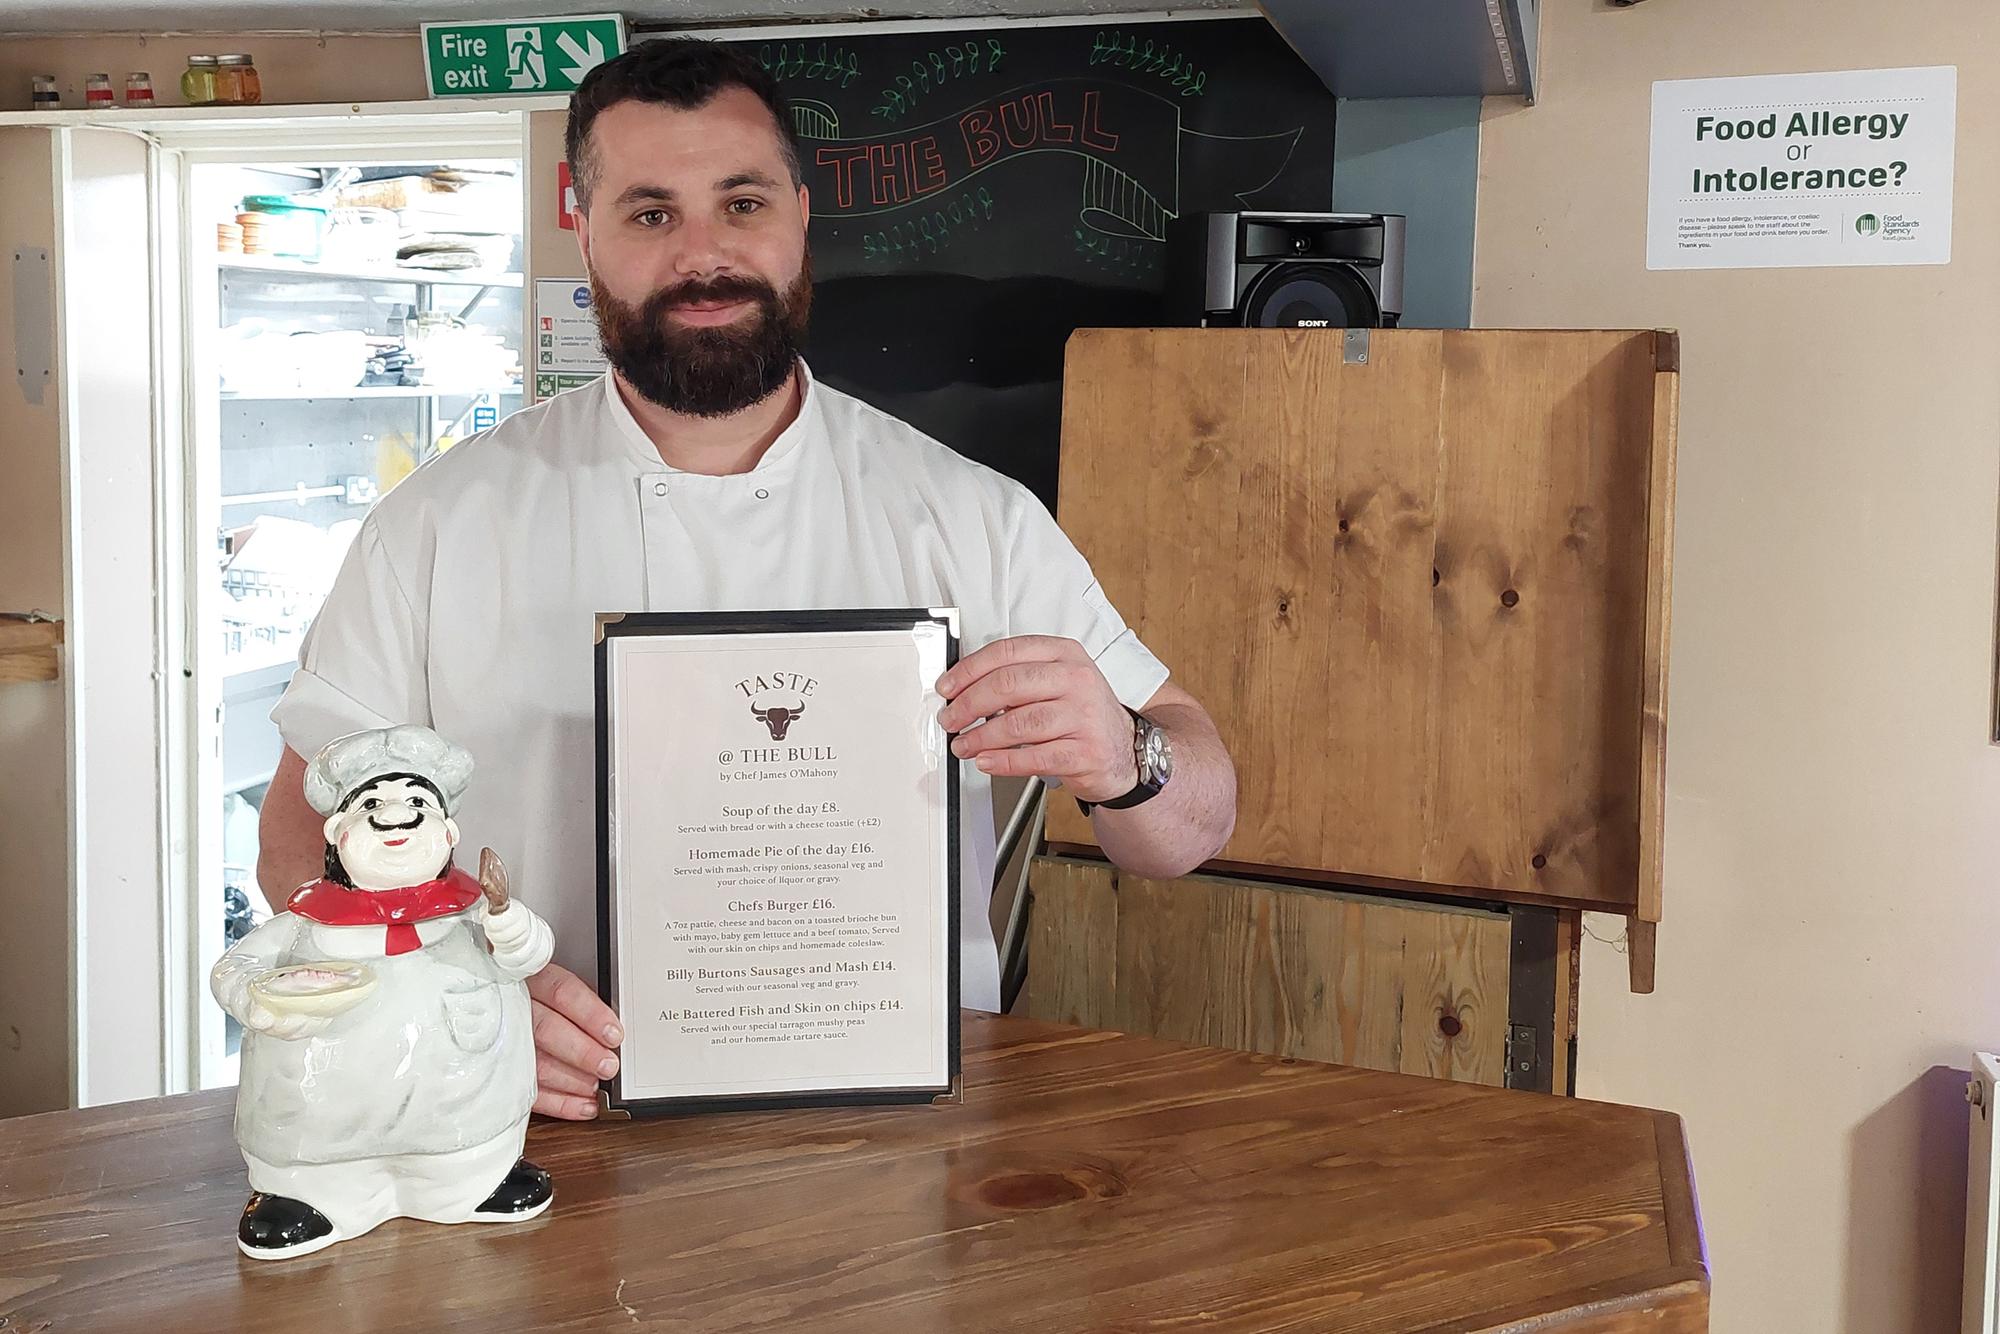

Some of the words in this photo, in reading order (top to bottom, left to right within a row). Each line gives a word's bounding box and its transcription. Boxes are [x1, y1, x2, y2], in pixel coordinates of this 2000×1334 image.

[441, 34, 487, 57] Fire
[443, 64, 488, 89] exit
[1696, 114, 1776, 141] Food
[1784, 111, 1909, 139] Allergy
[816, 136, 946, 207] THE
[959, 91, 1119, 167] BULL
[1787, 144, 1812, 161] or
[1693, 161, 1908, 192] Intolerance?
[735, 671, 819, 698] TASTE
[718, 750, 733, 765] @
[740, 748, 780, 763] THE
[788, 747, 836, 761] BULL
[720, 772, 731, 782] by
[734, 771, 756, 780] Chef
[759, 771, 786, 781] James
[722, 806, 753, 819] Soup
[756, 804, 770, 815] of
[774, 804, 793, 815] the
[797, 803, 818, 816] day
[822, 802, 839, 812] £8.
[678, 825, 706, 833] Served
[709, 824, 728, 832] with
[730, 823, 754, 831] bread
[767, 821, 786, 830] with
[795, 821, 824, 829] cheese
[826, 819, 854, 827] toastie
[857, 818, 881, 827] (+£2)
[689, 846, 760, 859] Homemade
[765, 846, 782, 856] Pie
[786, 845, 800, 856] of
[802, 845, 822, 855] the
[826, 844, 847, 857] day
[851, 842, 874, 853] £16.
[674, 866, 702, 875] Served
[726, 865, 750, 873] mash,
[753, 864, 778, 873] crispy
[781, 863, 811, 871] onions,
[814, 861, 848, 870] seasonal
[717, 880, 736, 888] your
[739, 877, 765, 885] choice
[768, 876, 776, 884] of
[779, 876, 803, 885] liquor
[817, 876, 840, 885] gravy.
[728, 900, 763, 912] Chefs
[767, 900, 808, 913] Burger
[813, 898, 835, 909] £16.
[673, 921, 688, 929] 7oz
[690, 920, 716, 931] pattie,
[719, 919, 747, 927] cheese
[749, 918, 765, 926] and
[767, 918, 792, 926] bacon
[815, 915, 845, 924] toasted
[847, 914, 878, 923] brioche
[673, 933, 691, 941] with
[694, 934, 719, 942] mayo,
[721, 932, 741, 942] baby
[743, 933, 760, 941] gem
[793, 929, 808, 937] and
[818, 928, 835, 936] beef
[872, 926, 899, 934] Served
[725, 944, 742, 952] skin
[758, 943, 779, 953] chips
[782, 942, 797, 950] and
[800, 940, 845, 949] homemade
[848, 939, 884, 947] coleslaw.
[667, 969, 694, 981] Billy
[698, 968, 746, 980] Burtons
[750, 966, 805, 977] Sausages
[809, 962, 831, 973] and
[836, 961, 868, 972] Mash
[873, 961, 895, 971] £14.
[695, 985, 723, 994] Served
[726, 984, 744, 992] with
[763, 982, 798, 990] seasonal
[801, 982, 815, 990] veg
[835, 980, 859, 989] gravy.
[659, 1010, 679, 1021] Ale
[683, 1006, 735, 1020] Battered
[739, 1005, 764, 1016] Fish
[768, 1004, 790, 1014] and
[795, 1003, 821, 1013] Skin
[825, 1004, 839, 1012] on
[844, 1000, 875, 1013] chips
[880, 1000, 903, 1010] £14.
[681, 1025, 709, 1033] Served
[749, 1021, 777, 1032] special
[780, 1021, 814, 1029] tarragon
[817, 1019, 844, 1027] mushy
[847, 1019, 865, 1027] peas
[711, 1036, 726, 1044] and
[745, 1033, 790, 1043] homemade
[793, 1032, 821, 1040] tartare
